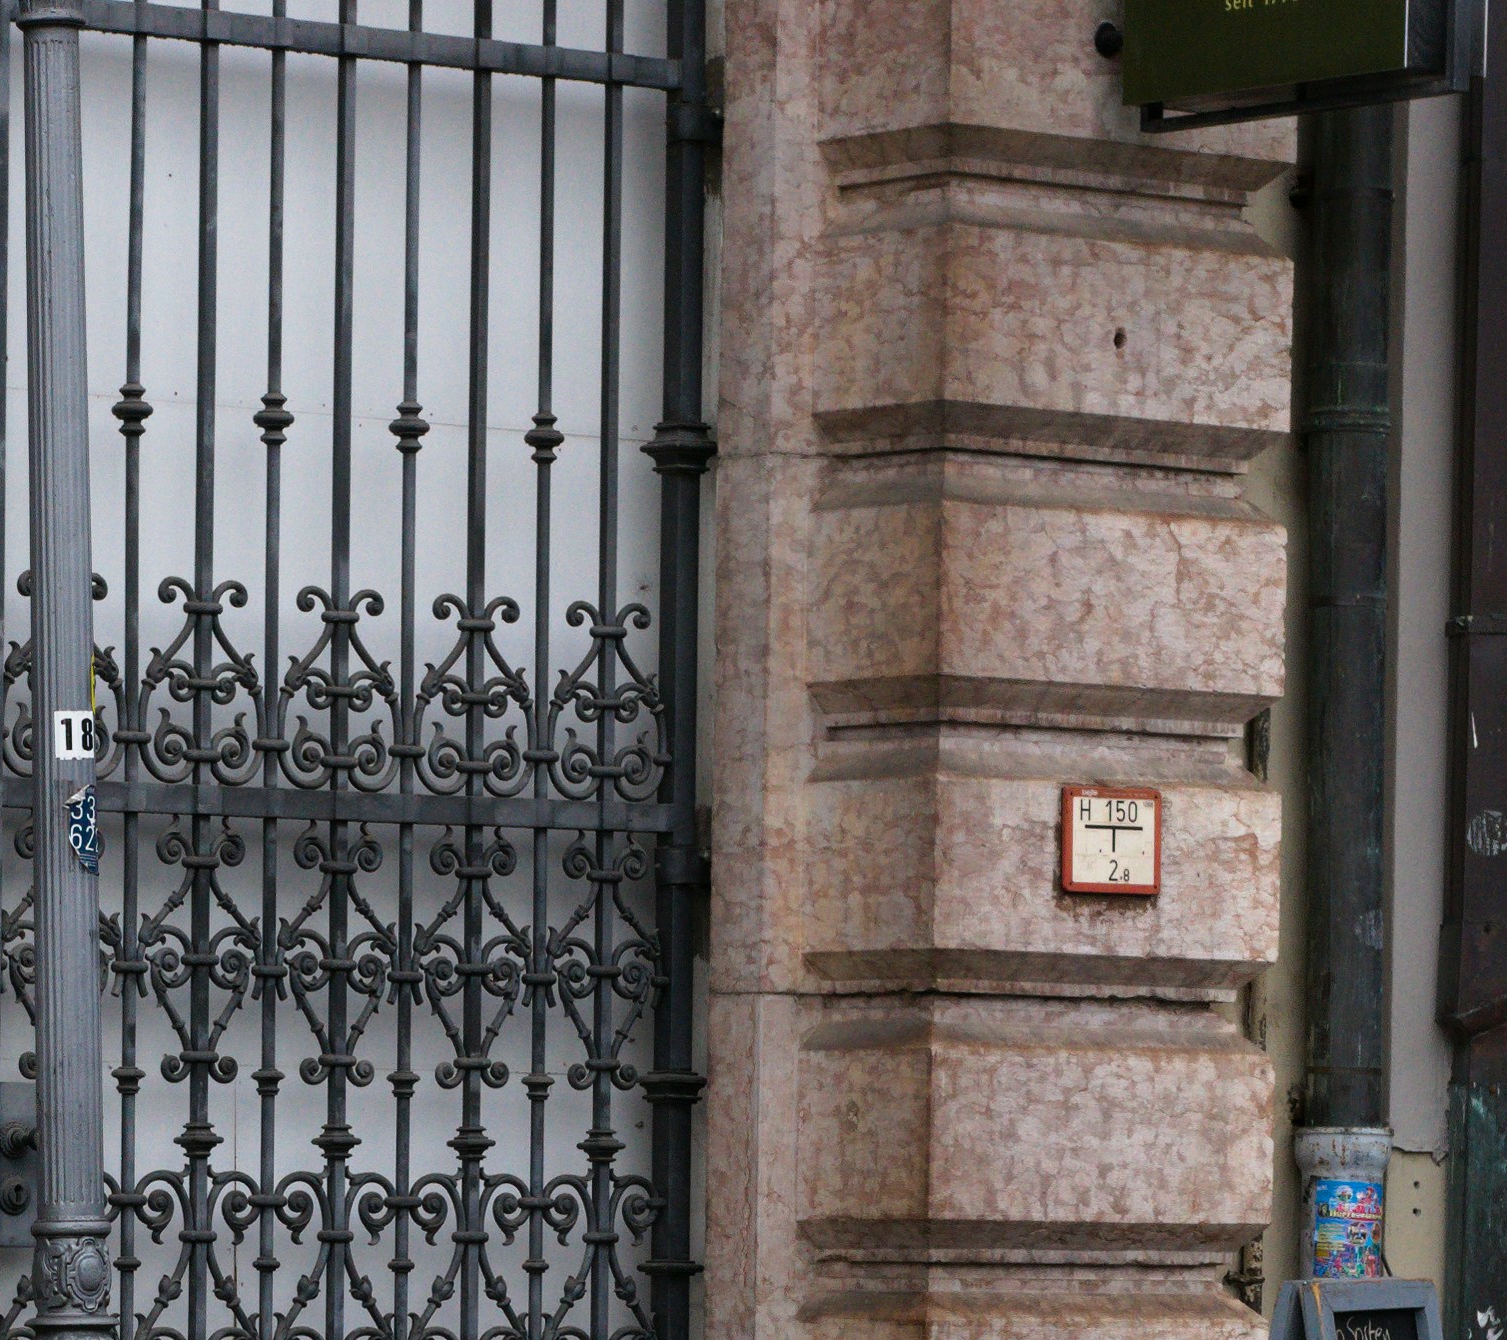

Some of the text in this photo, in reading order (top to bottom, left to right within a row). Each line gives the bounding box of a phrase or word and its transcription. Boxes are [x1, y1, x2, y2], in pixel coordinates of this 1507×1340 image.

[61, 717, 94, 752] 18
[1080, 799, 1138, 823] H 150
[69, 823, 99, 852] 62
